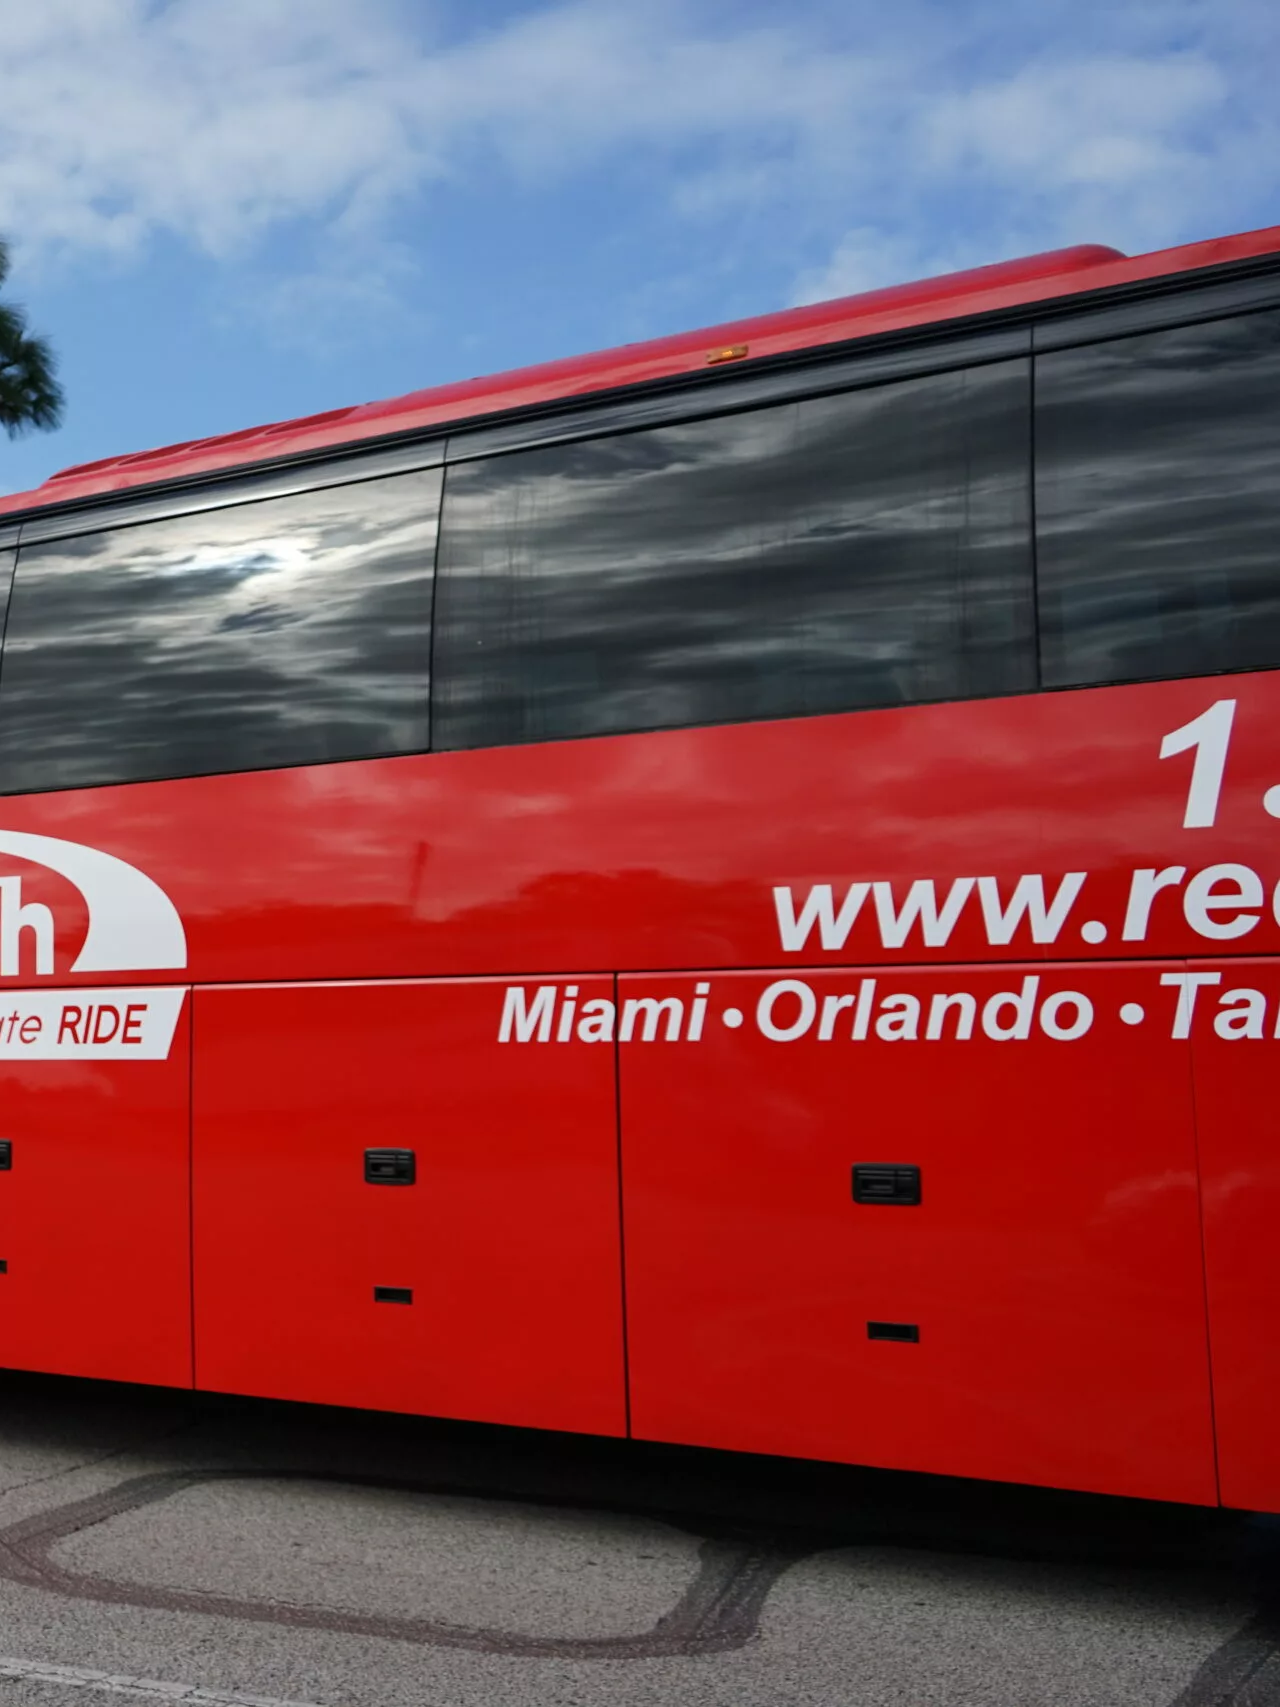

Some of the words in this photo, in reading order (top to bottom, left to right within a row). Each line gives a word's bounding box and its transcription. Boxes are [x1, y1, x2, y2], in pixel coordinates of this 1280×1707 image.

[774, 864, 1280, 951] www.re
[57, 1004, 148, 1045] RIDE
[498, 982, 710, 1043] Miami
[756, 975, 1094, 1042] Orlando
[1160, 972, 1280, 1040] Ta
